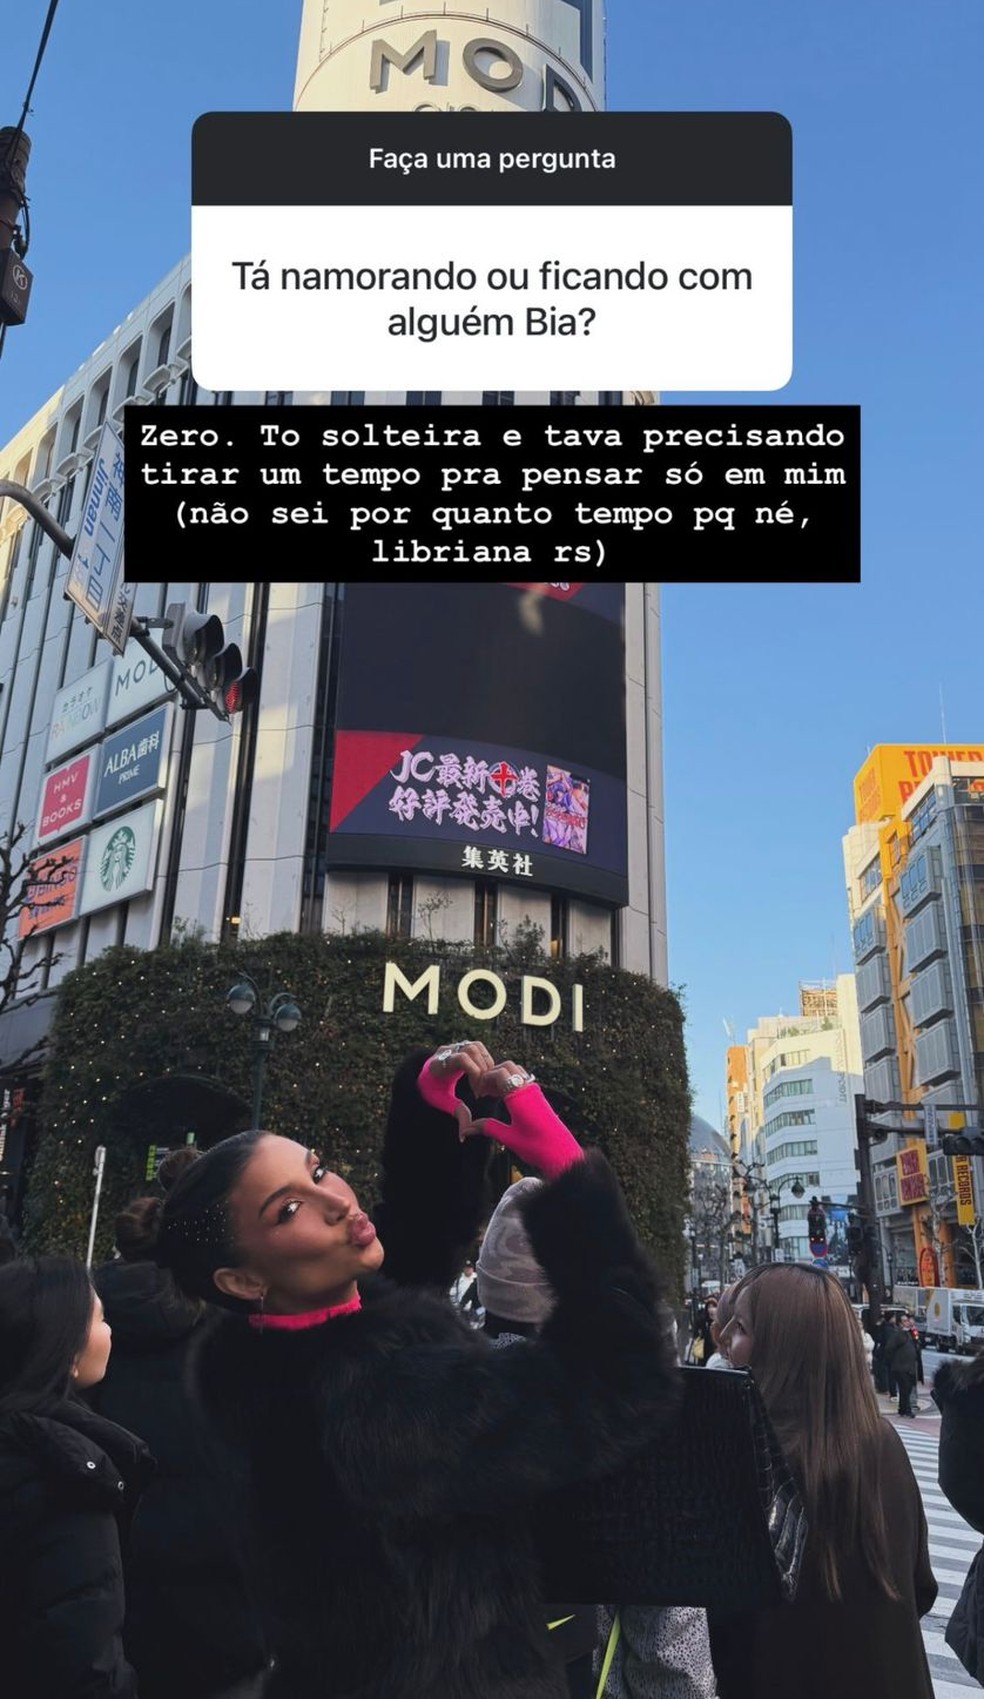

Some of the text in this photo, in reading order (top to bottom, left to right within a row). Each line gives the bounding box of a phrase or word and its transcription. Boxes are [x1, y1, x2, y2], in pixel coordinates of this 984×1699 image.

[84, 457, 109, 537] Jinnan
[53, 772, 79, 795] HMV
[42, 798, 82, 828] BOOKS
[461, 845, 534, 877] 集英社
[382, 961, 584, 1033] MODI
[957, 1164, 972, 1206] RECORDS
